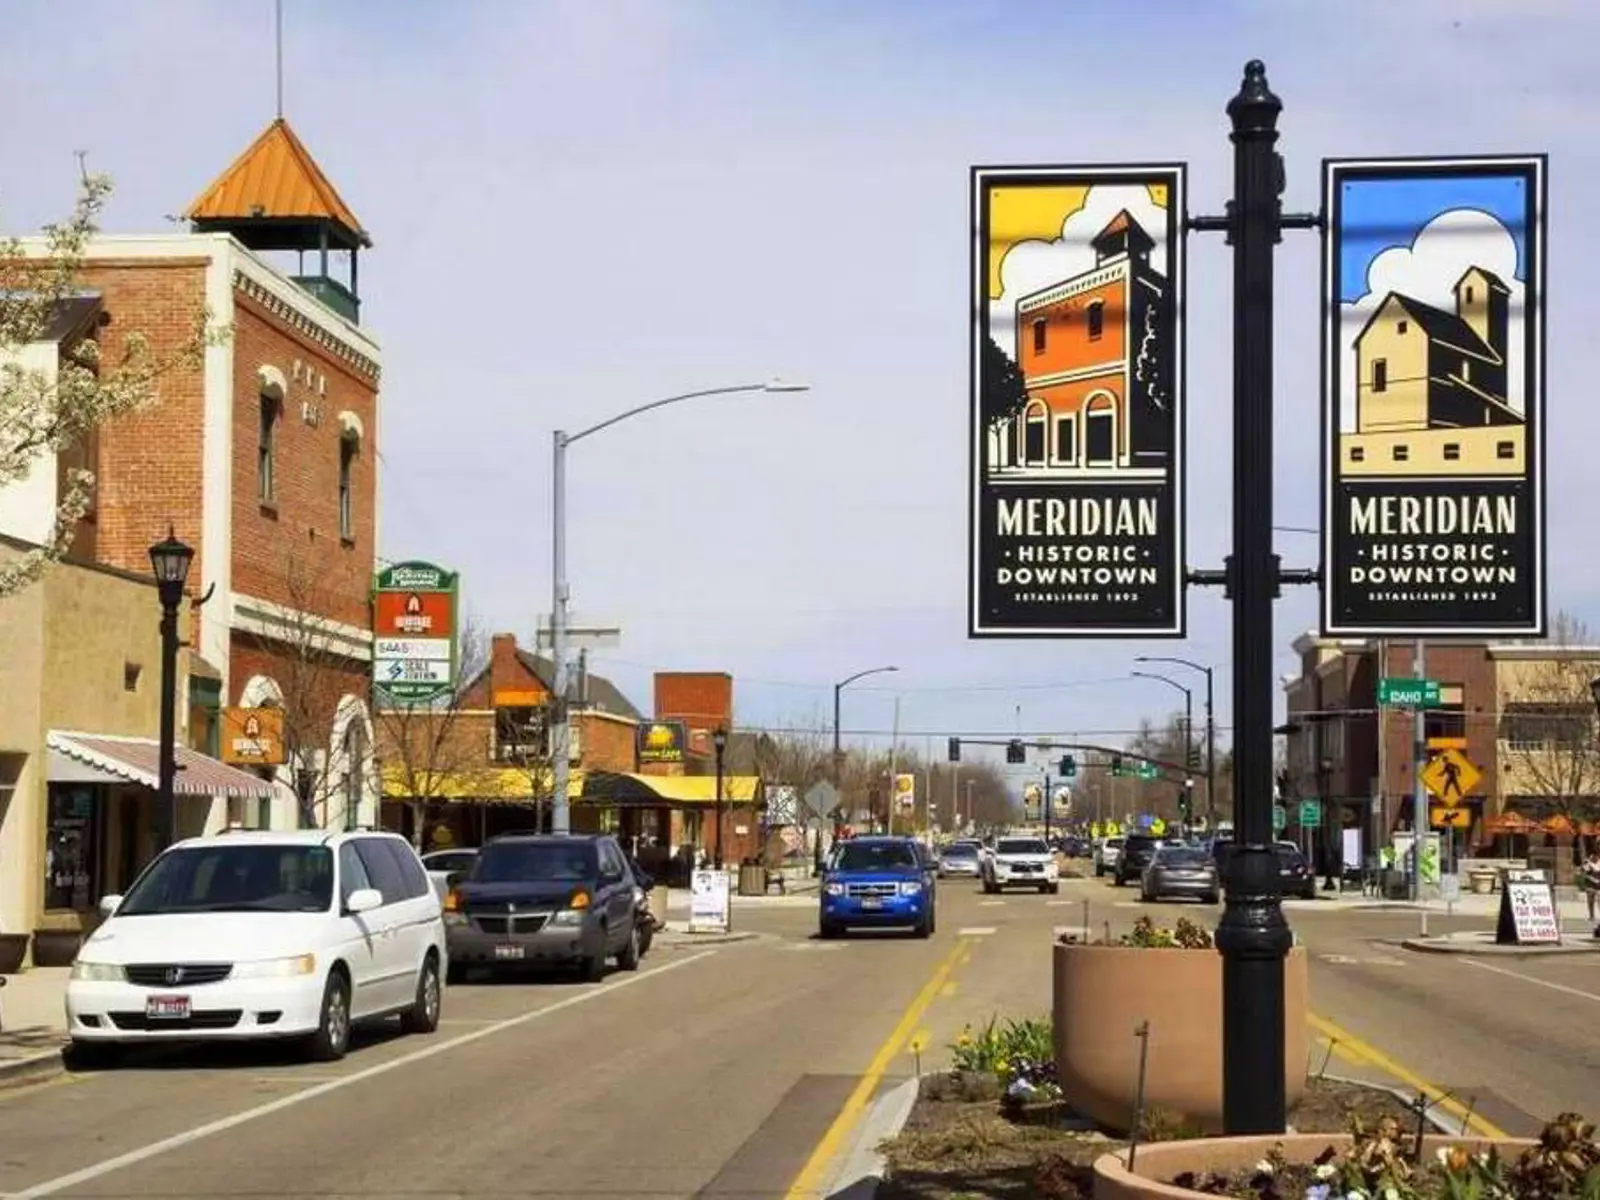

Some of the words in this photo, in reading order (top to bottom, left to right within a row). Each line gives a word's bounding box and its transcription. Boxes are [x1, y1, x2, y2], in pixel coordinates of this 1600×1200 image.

[997, 497, 1157, 536] MERIDIAN
[1350, 495, 1516, 535] MERIDIAN
[1018, 545, 1136, 563] HISTORIC
[1372, 543, 1495, 562] HISTORIC
[997, 567, 1157, 585] DOWNTOWN
[1350, 566, 1516, 584] DOWNTOWN
[1014, 592, 1099, 602] ESTABLISHED
[1369, 592, 1456, 601] ESTABLISHED
[1390, 691, 1422, 703] IDAHO
